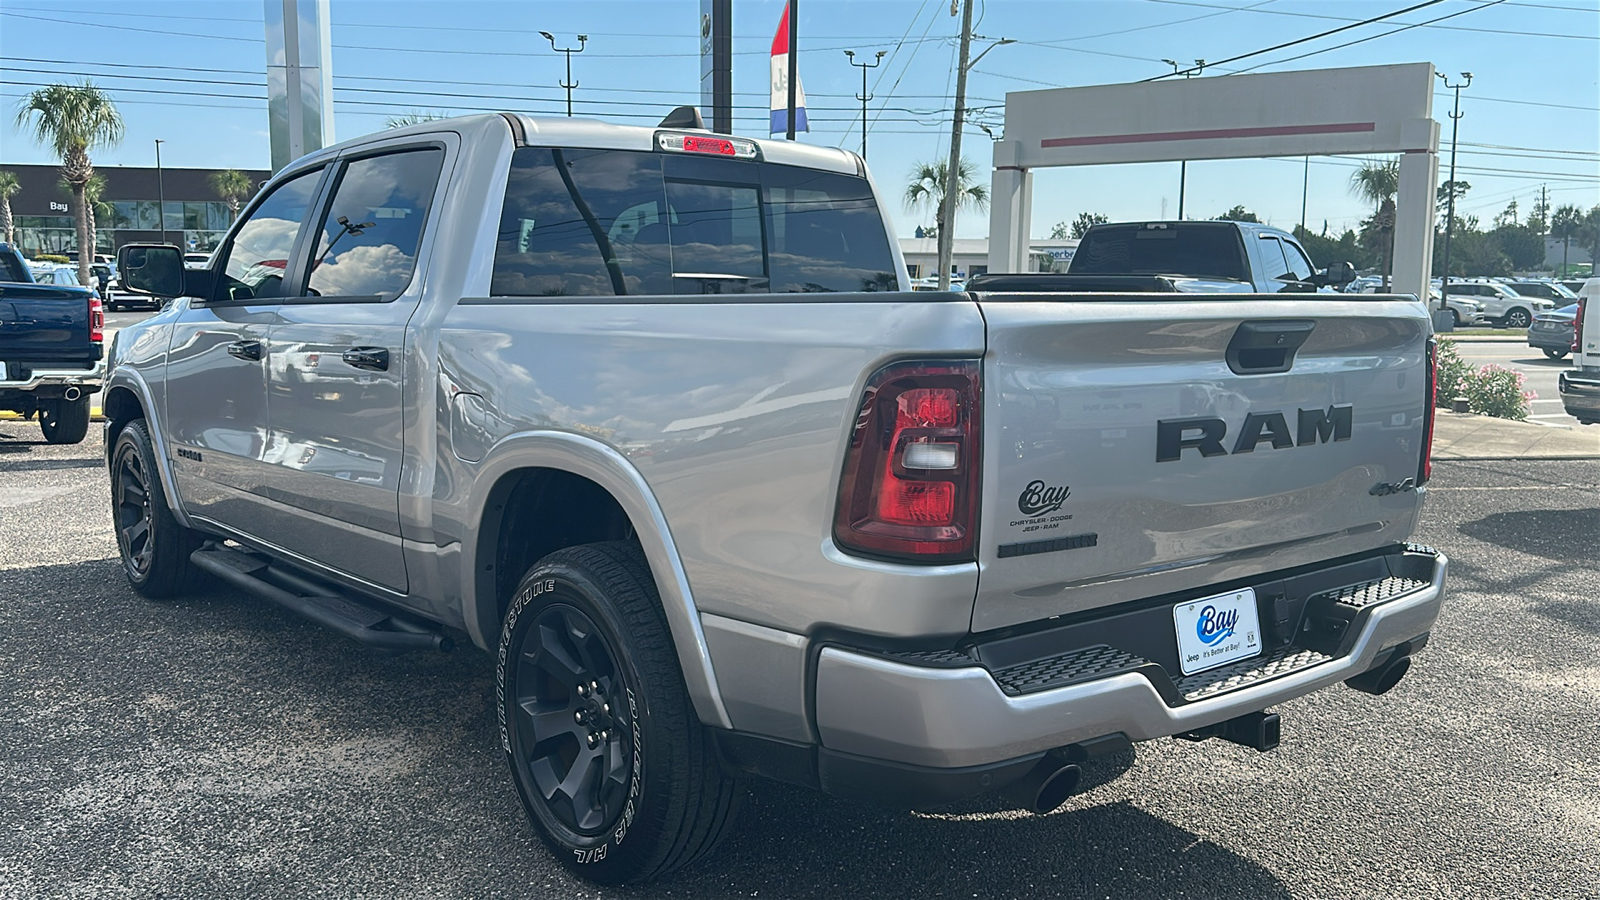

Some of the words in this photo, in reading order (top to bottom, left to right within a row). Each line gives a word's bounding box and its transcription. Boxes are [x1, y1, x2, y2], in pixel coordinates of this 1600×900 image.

[50, 201, 68, 213] Bay
[1156, 403, 1353, 463] RAM
[1019, 480, 1071, 513] Bay
[1009, 517, 1047, 527] CHRYSLER
[1050, 514, 1073, 523] DODGE
[1022, 525, 1040, 533] JEEP
[1043, 523, 1060, 531] RAM
[1197, 605, 1240, 640] Bay
[1186, 653, 1200, 663] Jeep
[1211, 647, 1224, 657] Better
[497, 579, 556, 754] BRIDGESTONE
[614, 687, 642, 845] DUELER
[573, 843, 608, 864] H/L
